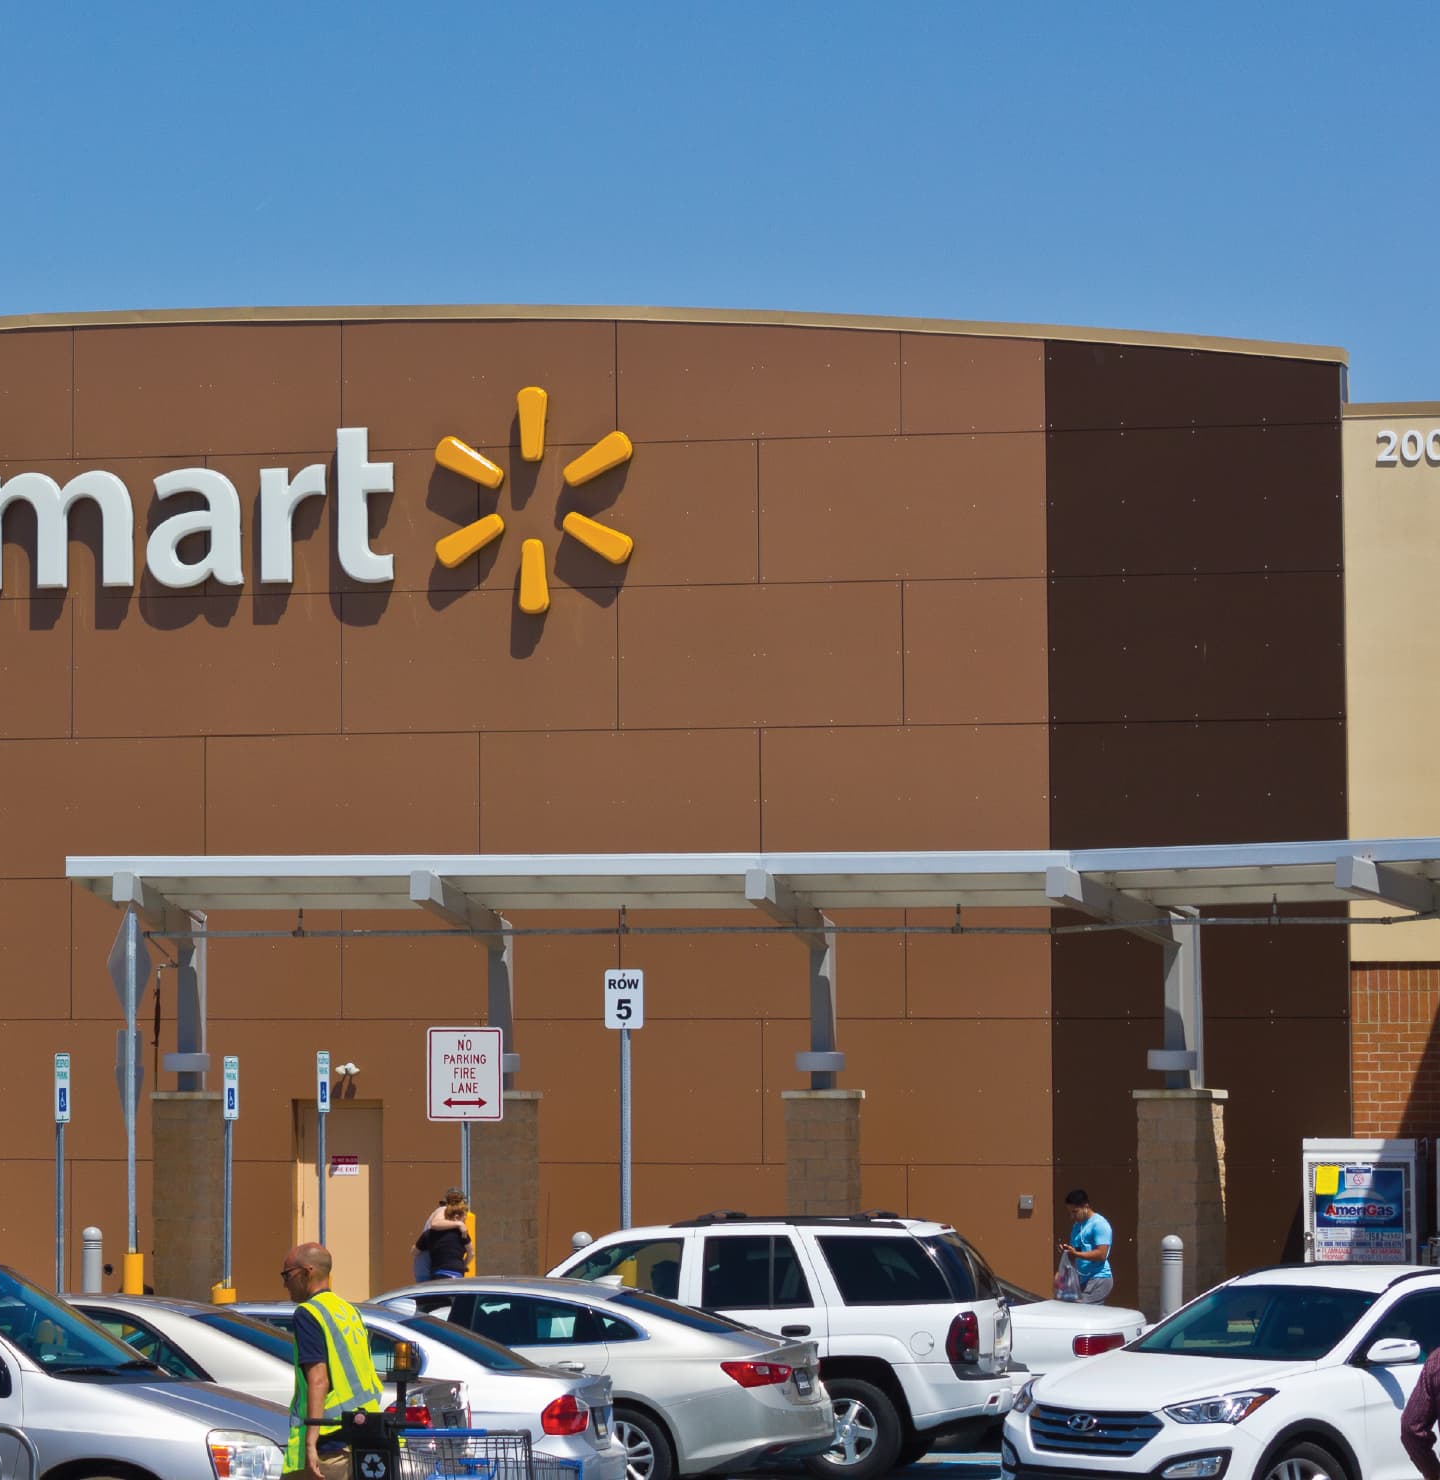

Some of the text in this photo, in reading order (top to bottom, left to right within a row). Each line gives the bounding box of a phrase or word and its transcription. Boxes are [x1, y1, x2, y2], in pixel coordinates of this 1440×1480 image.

[608, 979, 639, 990] ROW
[616, 999, 632, 1020] 5
[457, 1040, 472, 1051] NO
[443, 1054, 487, 1064] PARKING
[453, 1067, 476, 1079] FIRE
[451, 1082, 478, 1093] LANE
[1325, 1203, 1394, 1216] AmeriGas
